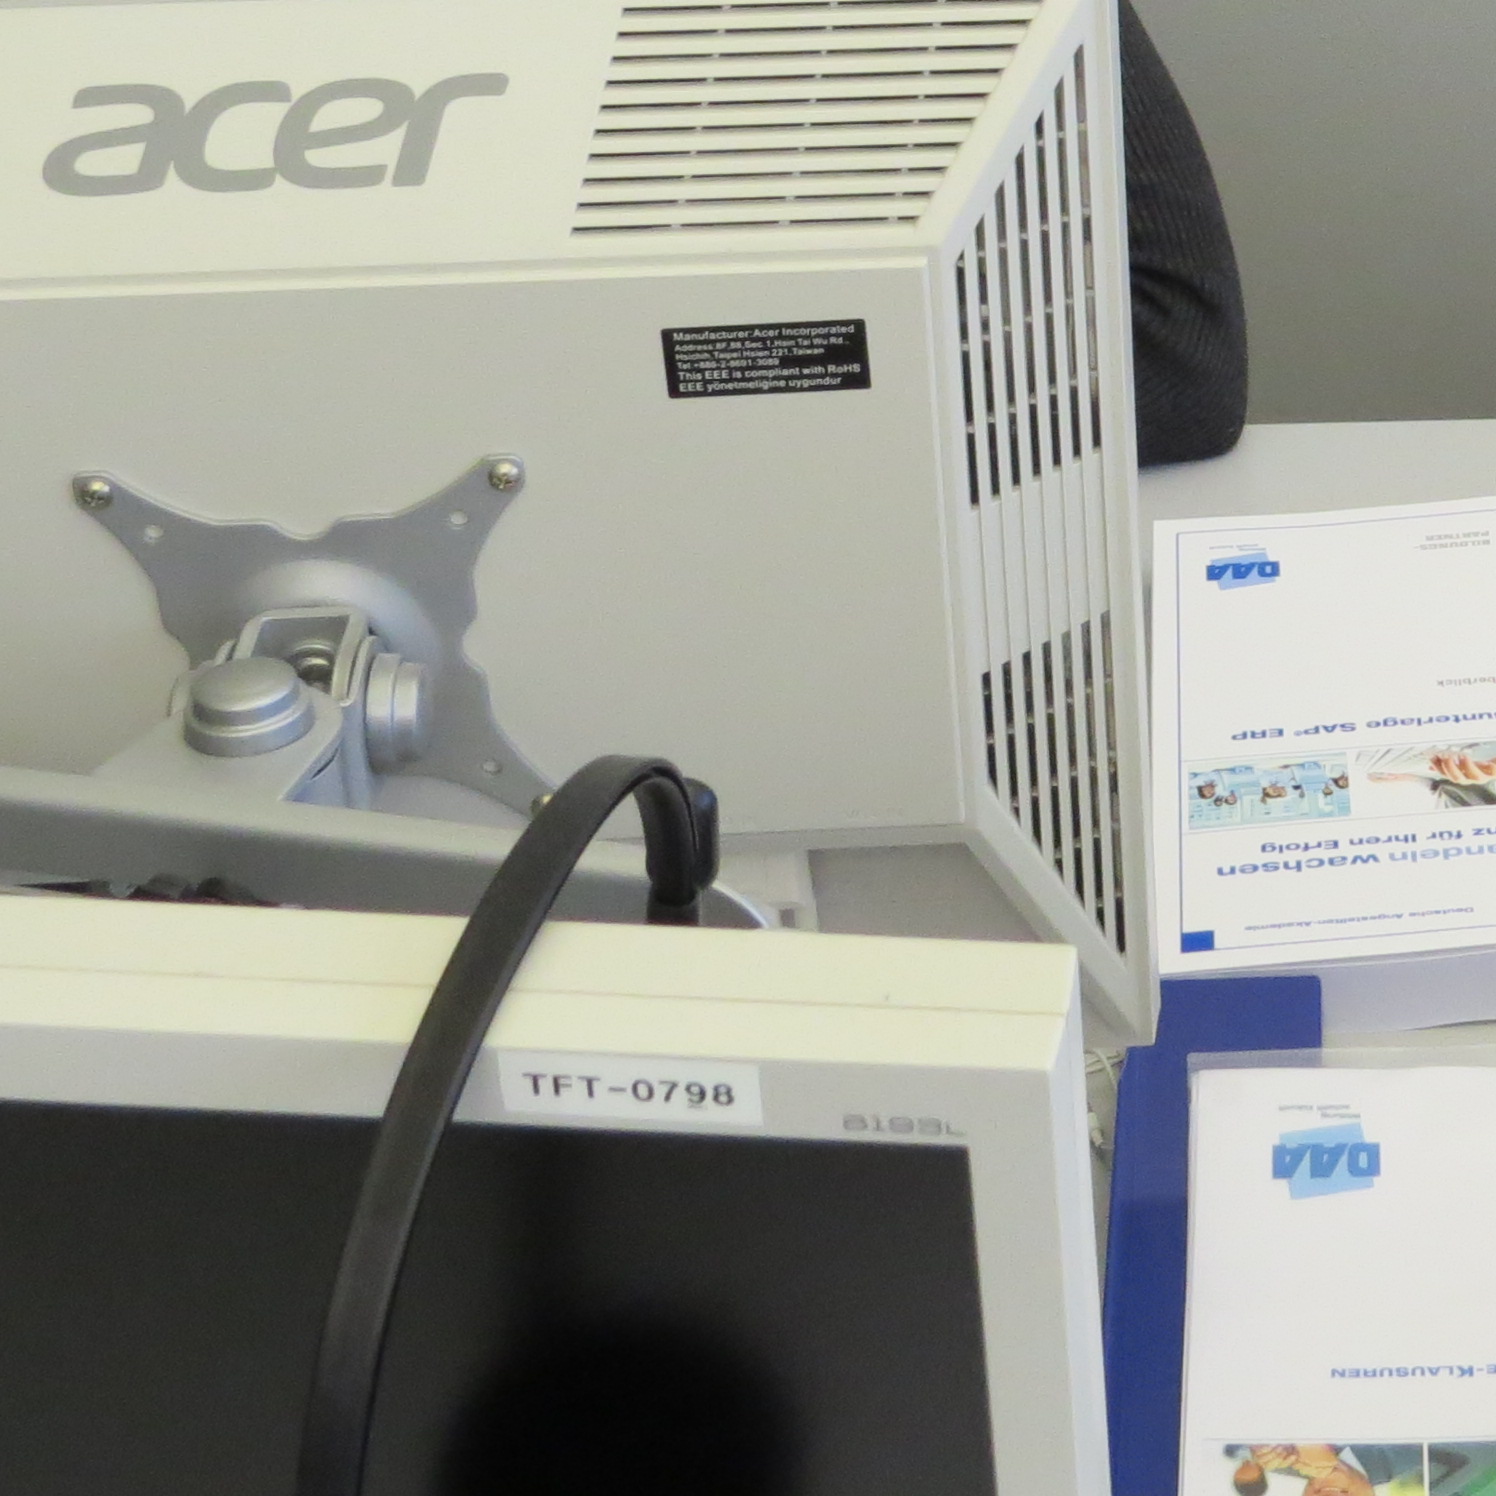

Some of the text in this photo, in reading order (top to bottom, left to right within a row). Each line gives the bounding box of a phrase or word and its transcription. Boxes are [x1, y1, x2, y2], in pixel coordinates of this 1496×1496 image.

[42, 72, 510, 197] acer
[781, 324, 855, 336] Incorporated
[678, 363, 861, 381] This EEE is compliant with RoHS
[679, 381, 704, 393] EEE
[788, 376, 842, 389] uygundur
[1206, 561, 1281, 581] DAA
[1231, 728, 1285, 741] ERP
[1349, 832, 1417, 848] Ihren
[1426, 829, 1463, 844] für
[1260, 839, 1339, 856] Erfolg
[1216, 853, 1380, 879] wachsen
[522, 1072, 736, 1107] TFT-0798
[1272, 1142, 1381, 1180] DAA
